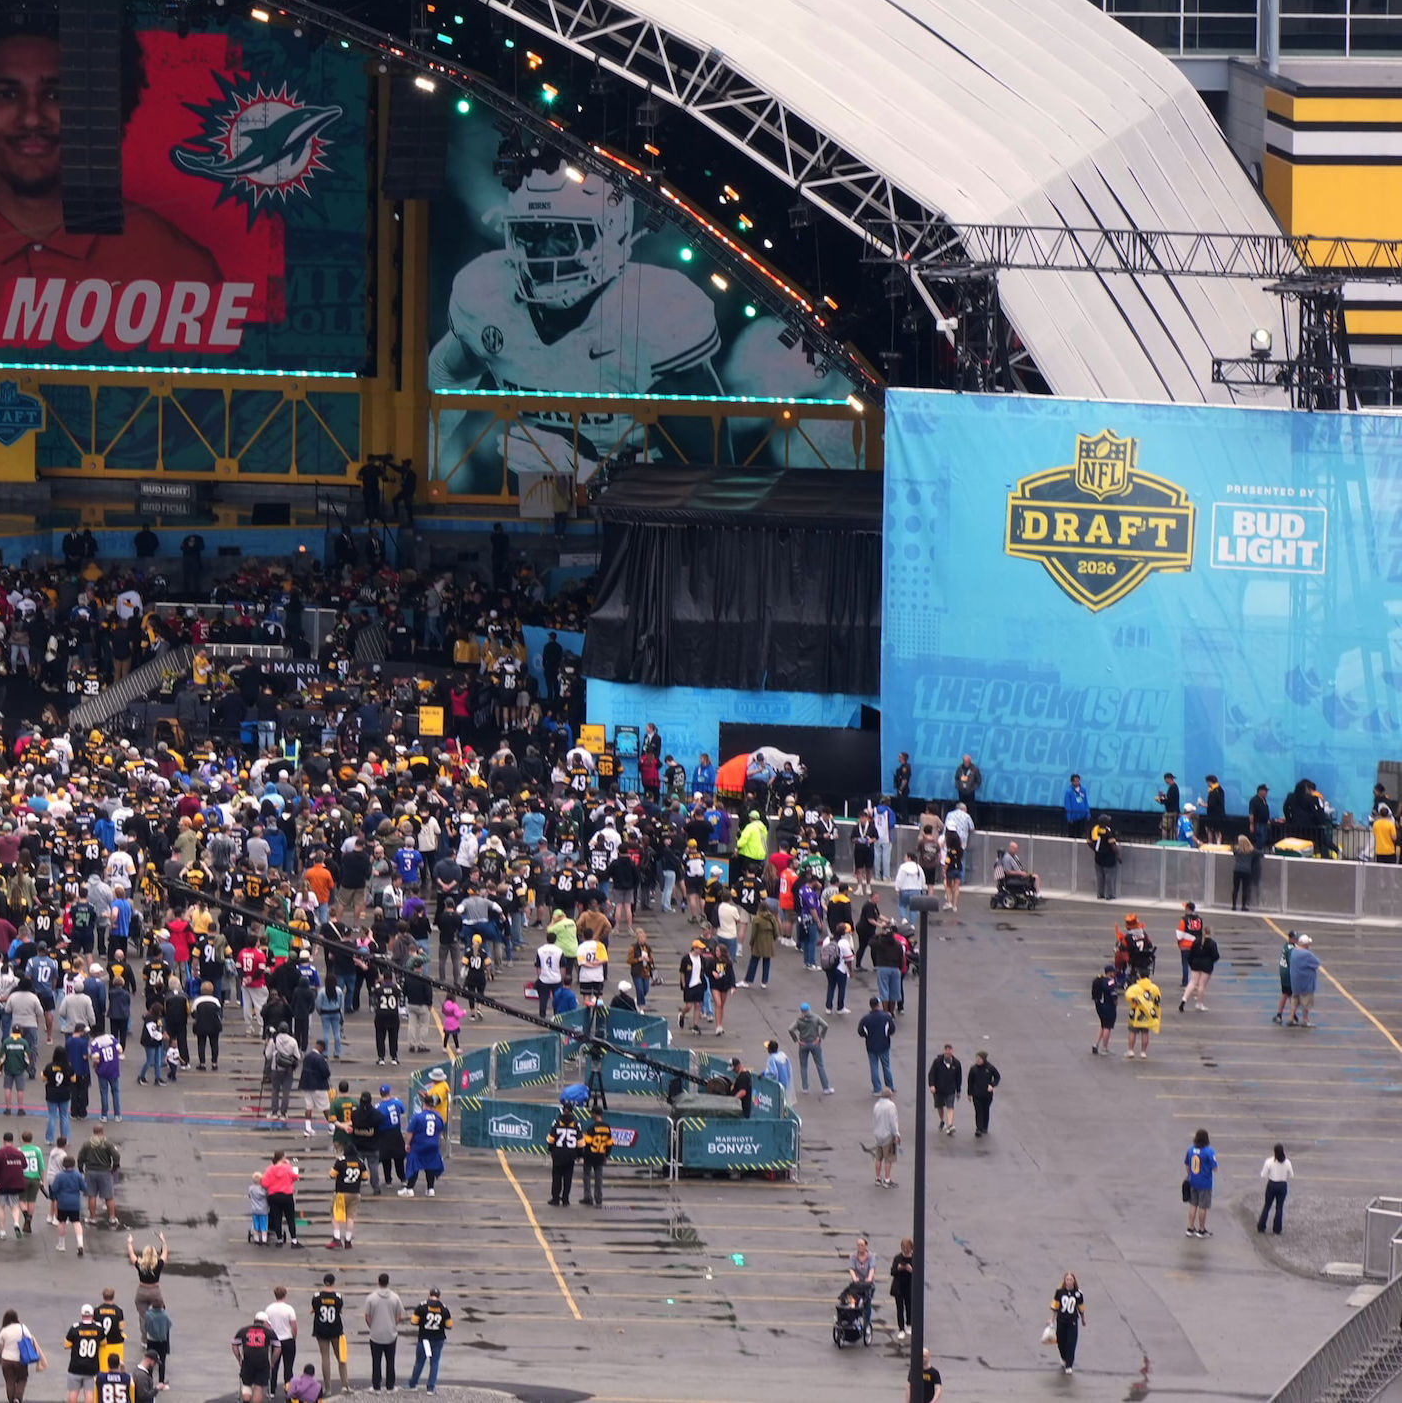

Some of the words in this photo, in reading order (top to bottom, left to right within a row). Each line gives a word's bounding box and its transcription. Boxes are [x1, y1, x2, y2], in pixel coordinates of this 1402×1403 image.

[2, 277, 255, 346] MOORE
[1082, 461, 1122, 487] NFL
[143, 485, 160, 494] BUD
[161, 486, 188, 496] LIGHT
[1226, 484, 1295, 498] PRESENTED
[1300, 488, 1316, 498] BY
[1021, 510, 1177, 548] DRAFT
[1233, 510, 1305, 539] BUD
[1217, 536, 1318, 567] LIGHT
[1077, 560, 1117, 576] 2026
[274, 662, 320, 675] MARRI
[426, 1121, 434, 1135] 8
[556, 1128, 577, 1147] 75
[707, 1143, 761, 1155] BONVOY
[320, 1307, 335, 1323] 30
[426, 1313, 441, 1329] 22
[79, 1339, 96, 1357] 80
[103, 1384, 126, 1403] 85
